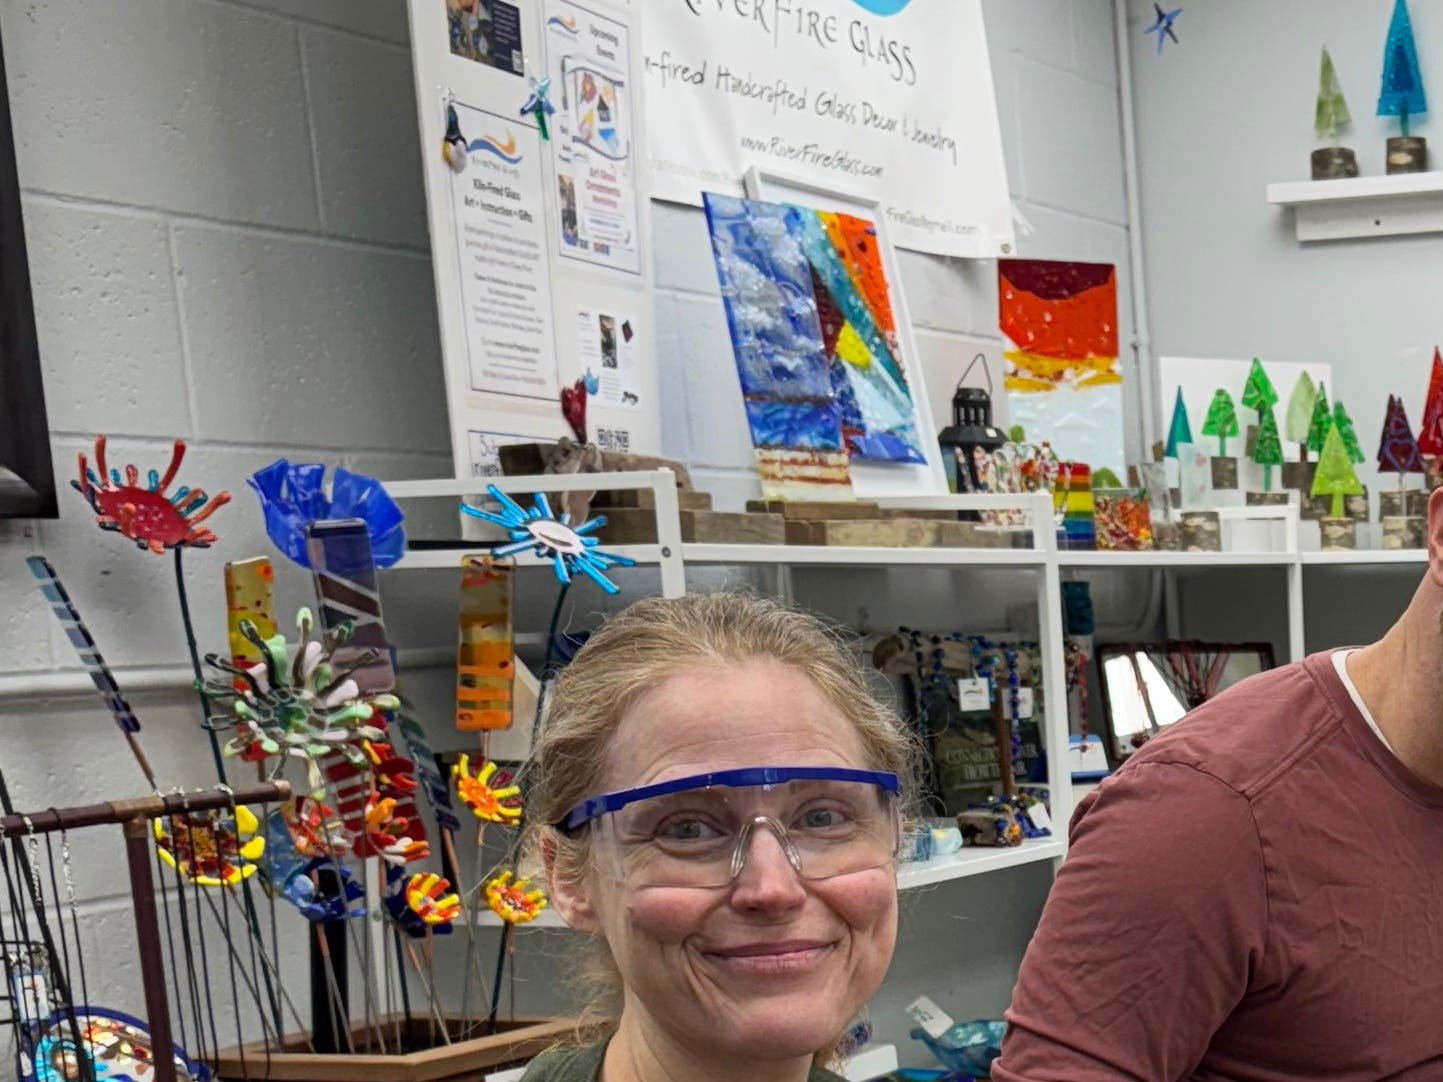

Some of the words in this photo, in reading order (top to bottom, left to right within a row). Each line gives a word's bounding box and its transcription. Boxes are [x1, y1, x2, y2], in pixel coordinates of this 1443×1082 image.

[849, 21, 917, 86] GLASS
[715, 64, 808, 114] Handcrafted
[814, 91, 857, 125] Glass
[862, 101, 897, 130] Decor
